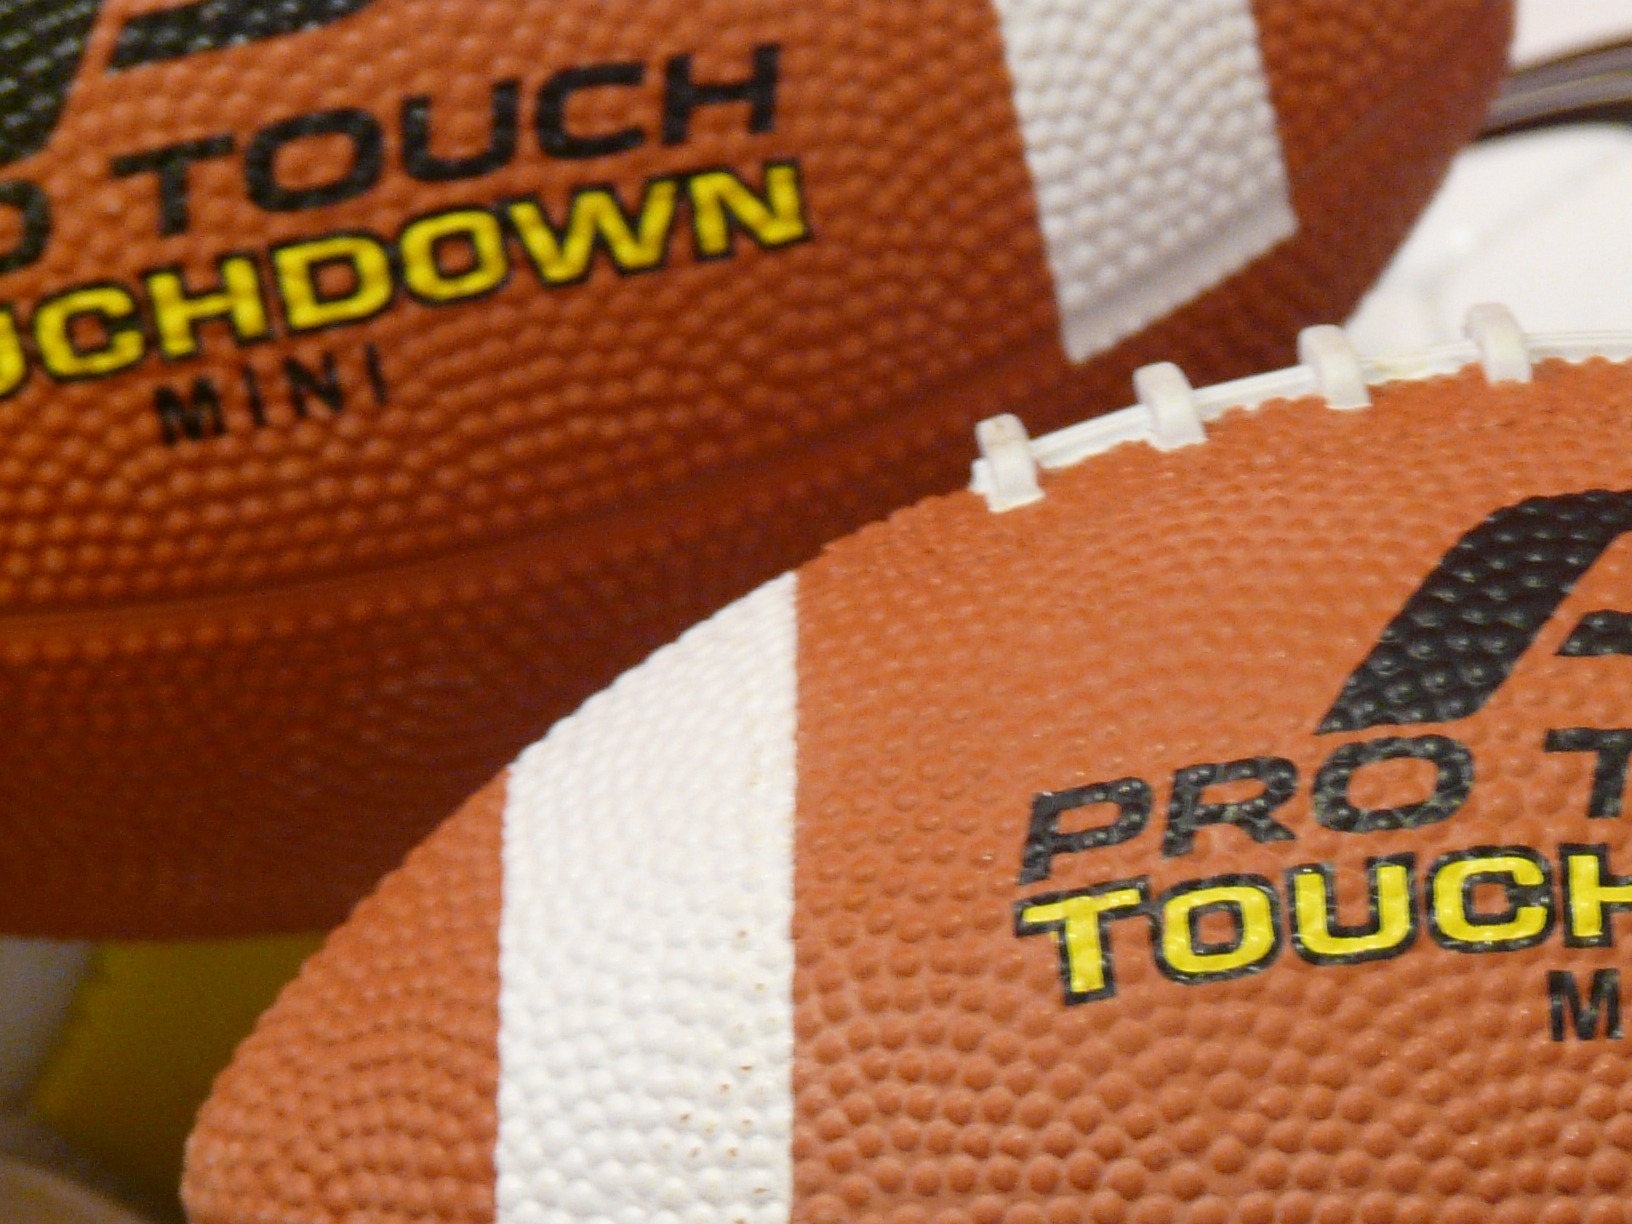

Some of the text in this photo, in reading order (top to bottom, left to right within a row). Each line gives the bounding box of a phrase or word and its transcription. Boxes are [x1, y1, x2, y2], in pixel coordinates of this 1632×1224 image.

[112, 43, 783, 237] TOUCH
[0, 156, 813, 397] CHDOWN
[153, 342, 390, 446] MINI
[1017, 734, 1475, 886] PRO
